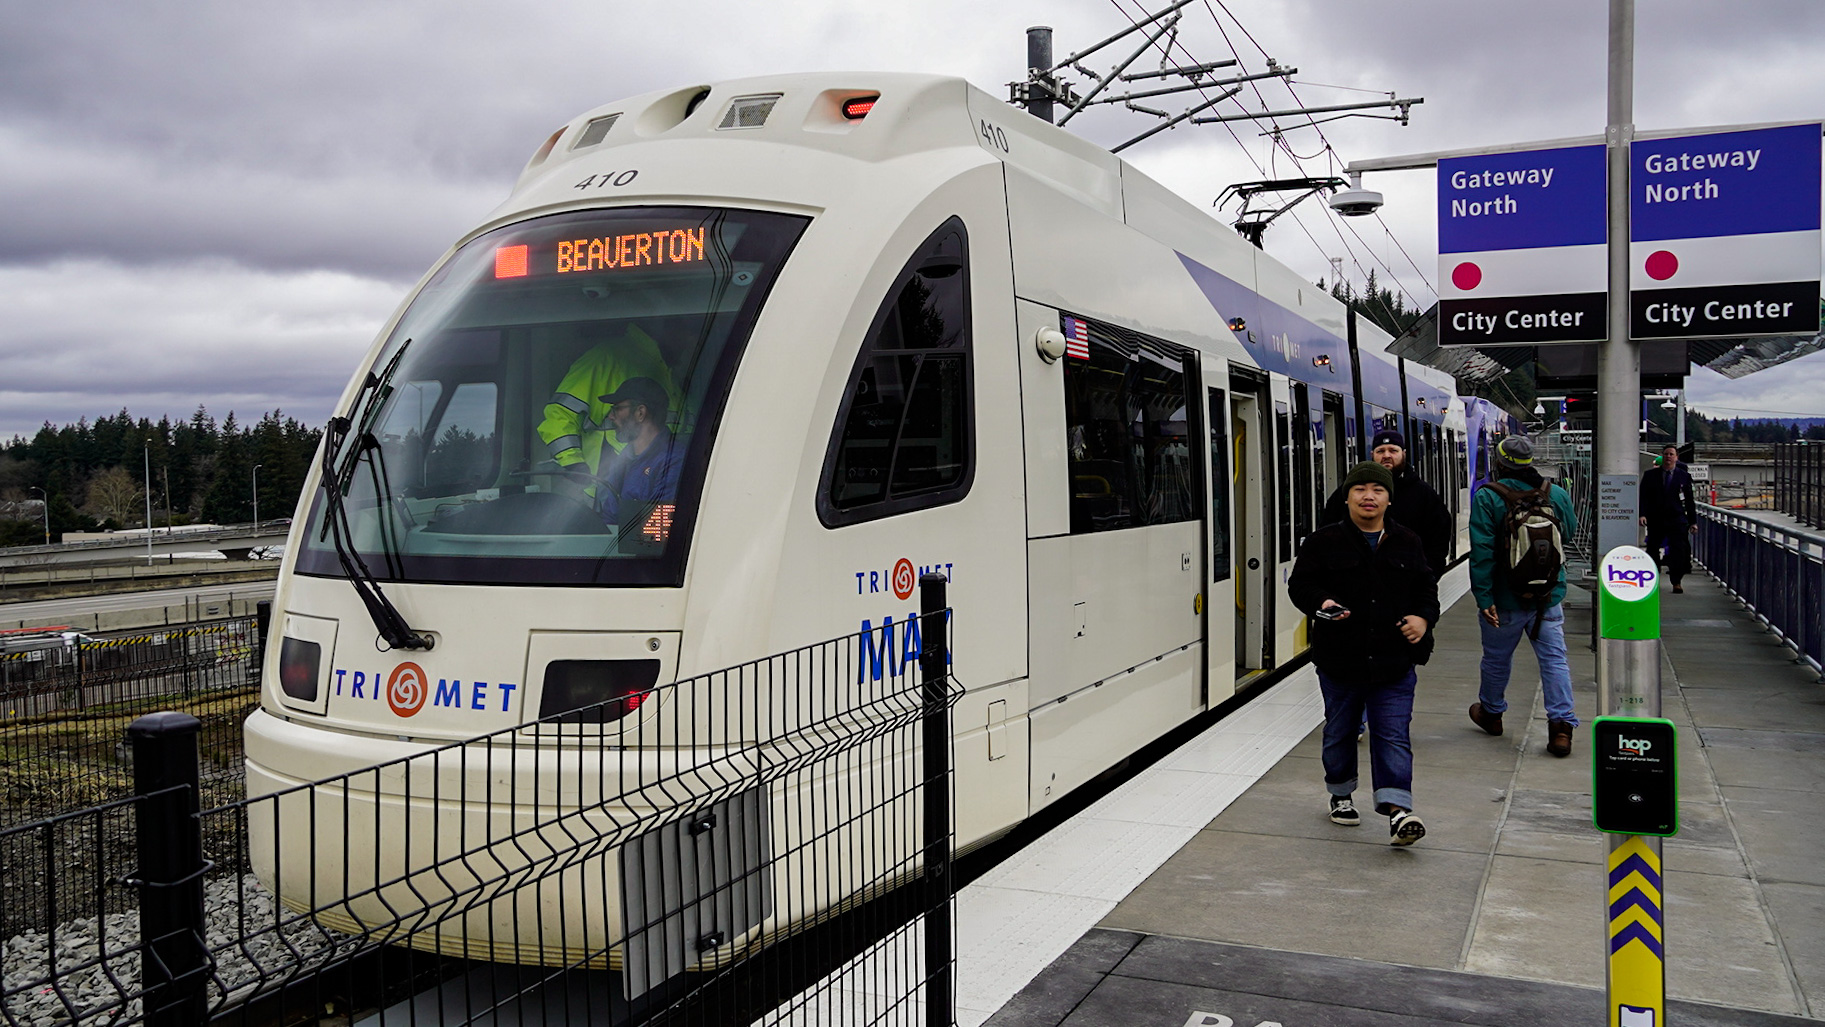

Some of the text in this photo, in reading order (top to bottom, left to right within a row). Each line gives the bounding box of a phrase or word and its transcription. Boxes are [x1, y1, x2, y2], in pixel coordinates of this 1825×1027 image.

[980, 118, 1010, 154] 410
[1644, 148, 1762, 176] Gateway
[573, 168, 639, 191] 410
[1450, 166, 1555, 190] Gateway
[1644, 178, 1720, 204] North
[1450, 195, 1518, 218] North
[556, 226, 706, 274] BEAVERTON
[1451, 307, 1585, 336] City Center
[1644, 298, 1794, 328] City Center
[855, 569, 889, 594] TRI
[1607, 564, 1655, 588] hop
[857, 607, 952, 685] MA
[334, 668, 518, 713] TRI MET
[1618, 734, 1652, 756] hop
